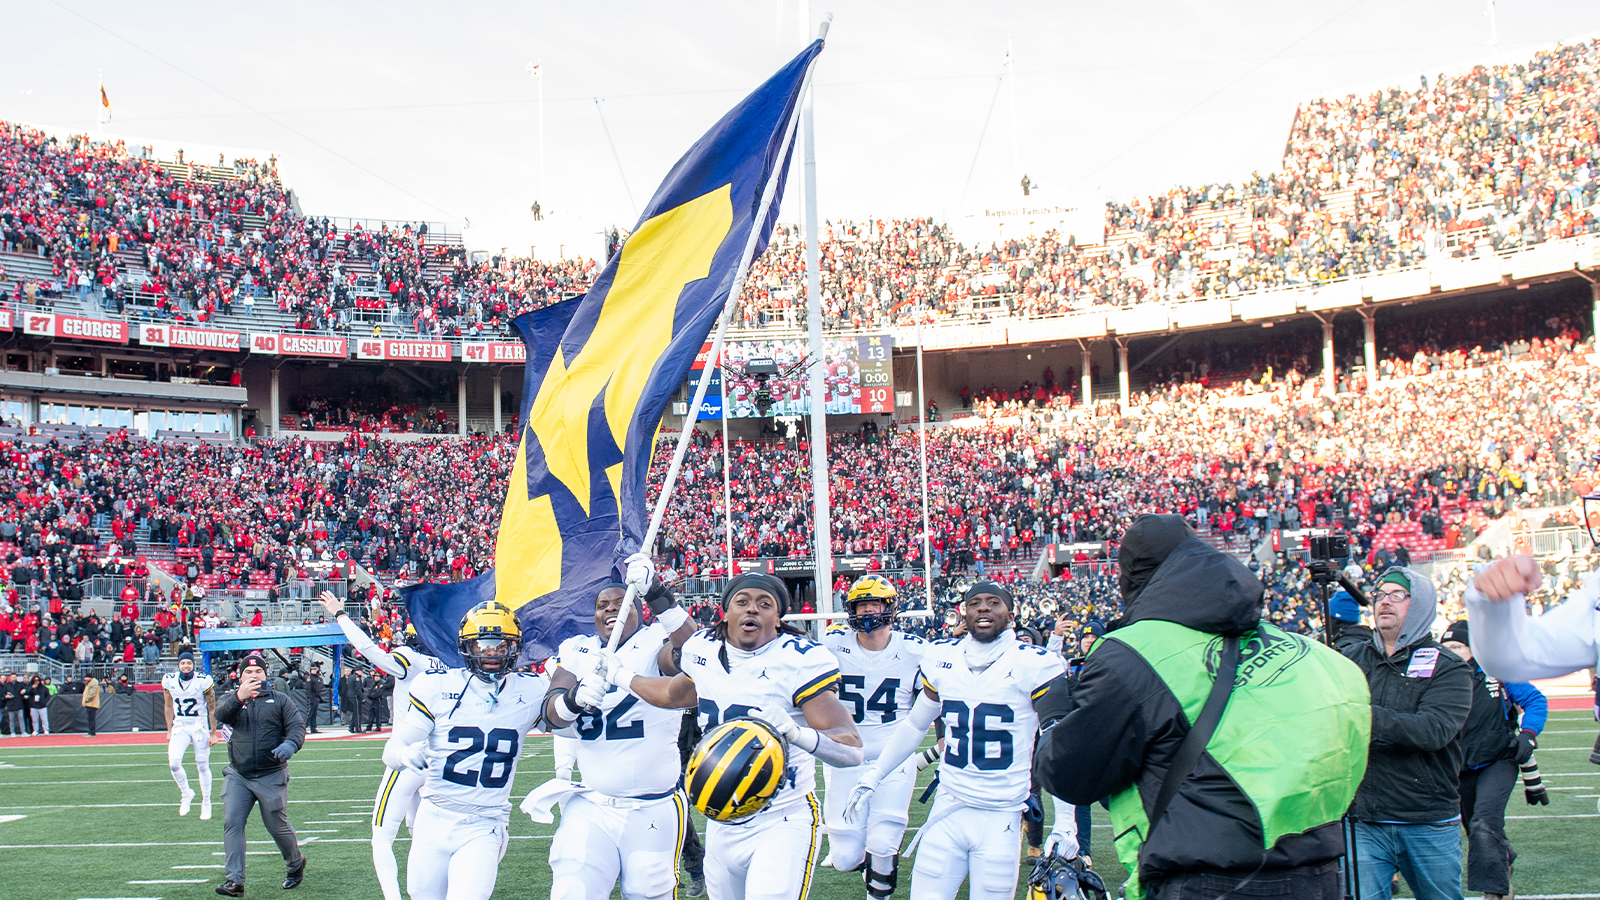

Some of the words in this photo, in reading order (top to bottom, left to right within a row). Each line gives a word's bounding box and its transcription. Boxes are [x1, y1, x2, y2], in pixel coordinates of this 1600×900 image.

[1022, 207, 1051, 215] Family
[1055, 205, 1079, 213] Tower
[30, 315, 51, 332] 27
[62, 318, 122, 340] GEORGE
[145, 328, 165, 343] 31
[170, 328, 240, 349] JANOWICZ
[254, 335, 276, 351] 40
[282, 337, 342, 354] CASSADY
[361, 341, 381, 356] 45
[389, 342, 446, 359] GRIFFIN
[466, 345, 485, 360] 47
[868, 346, 885, 359] 13
[865, 373, 888, 383] 0:00
[869, 389, 887, 402] 10
[1234, 640, 1296, 686] SPORTS
[174, 697, 199, 716] 12
[839, 674, 900, 724] 54
[941, 699, 1014, 771] 36
[442, 726, 519, 789] 28
